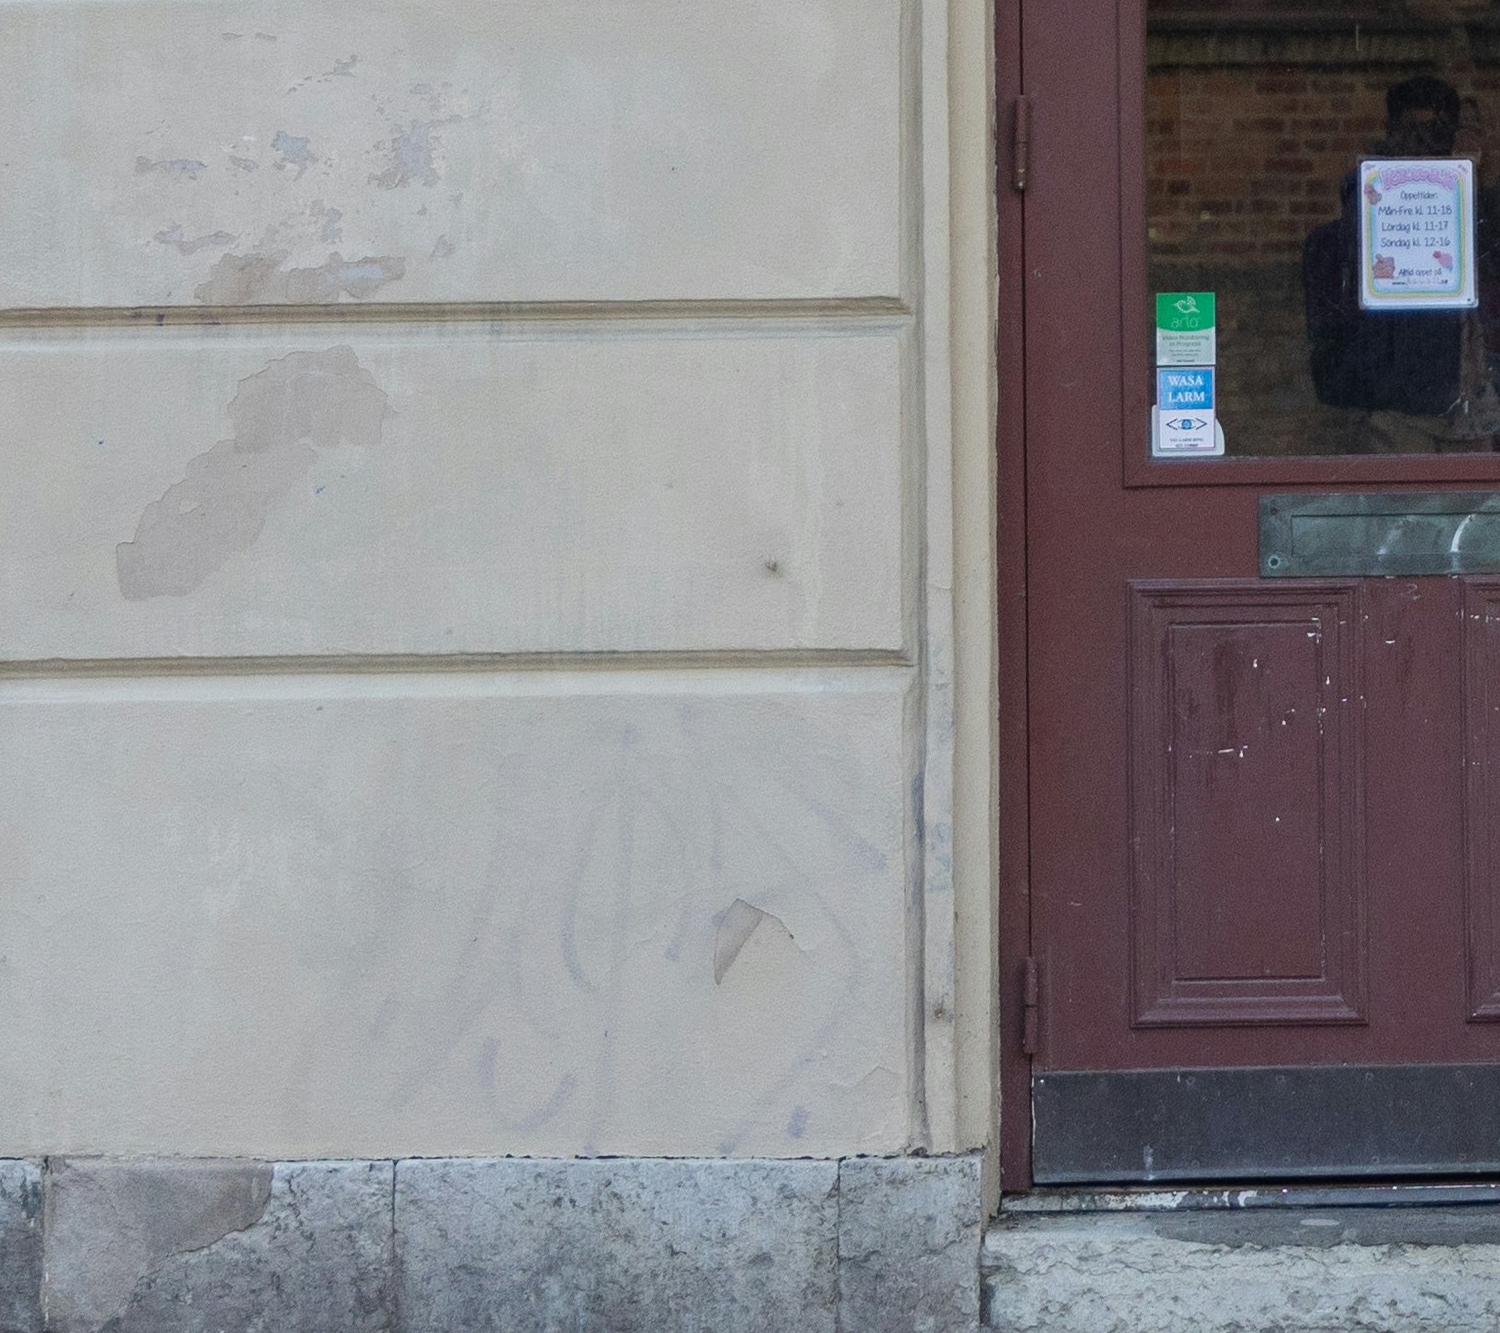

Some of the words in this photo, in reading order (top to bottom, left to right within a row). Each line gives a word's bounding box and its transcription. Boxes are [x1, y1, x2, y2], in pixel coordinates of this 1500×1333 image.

[1427, 205, 1452, 215] 11-18
[1425, 221, 1448, 231] 11-17
[1425, 237, 1451, 247] 12-16
[1171, 315, 1200, 329] arlo
[1168, 375, 1203, 386] WASA
[1168, 391, 1205, 402] LARM
